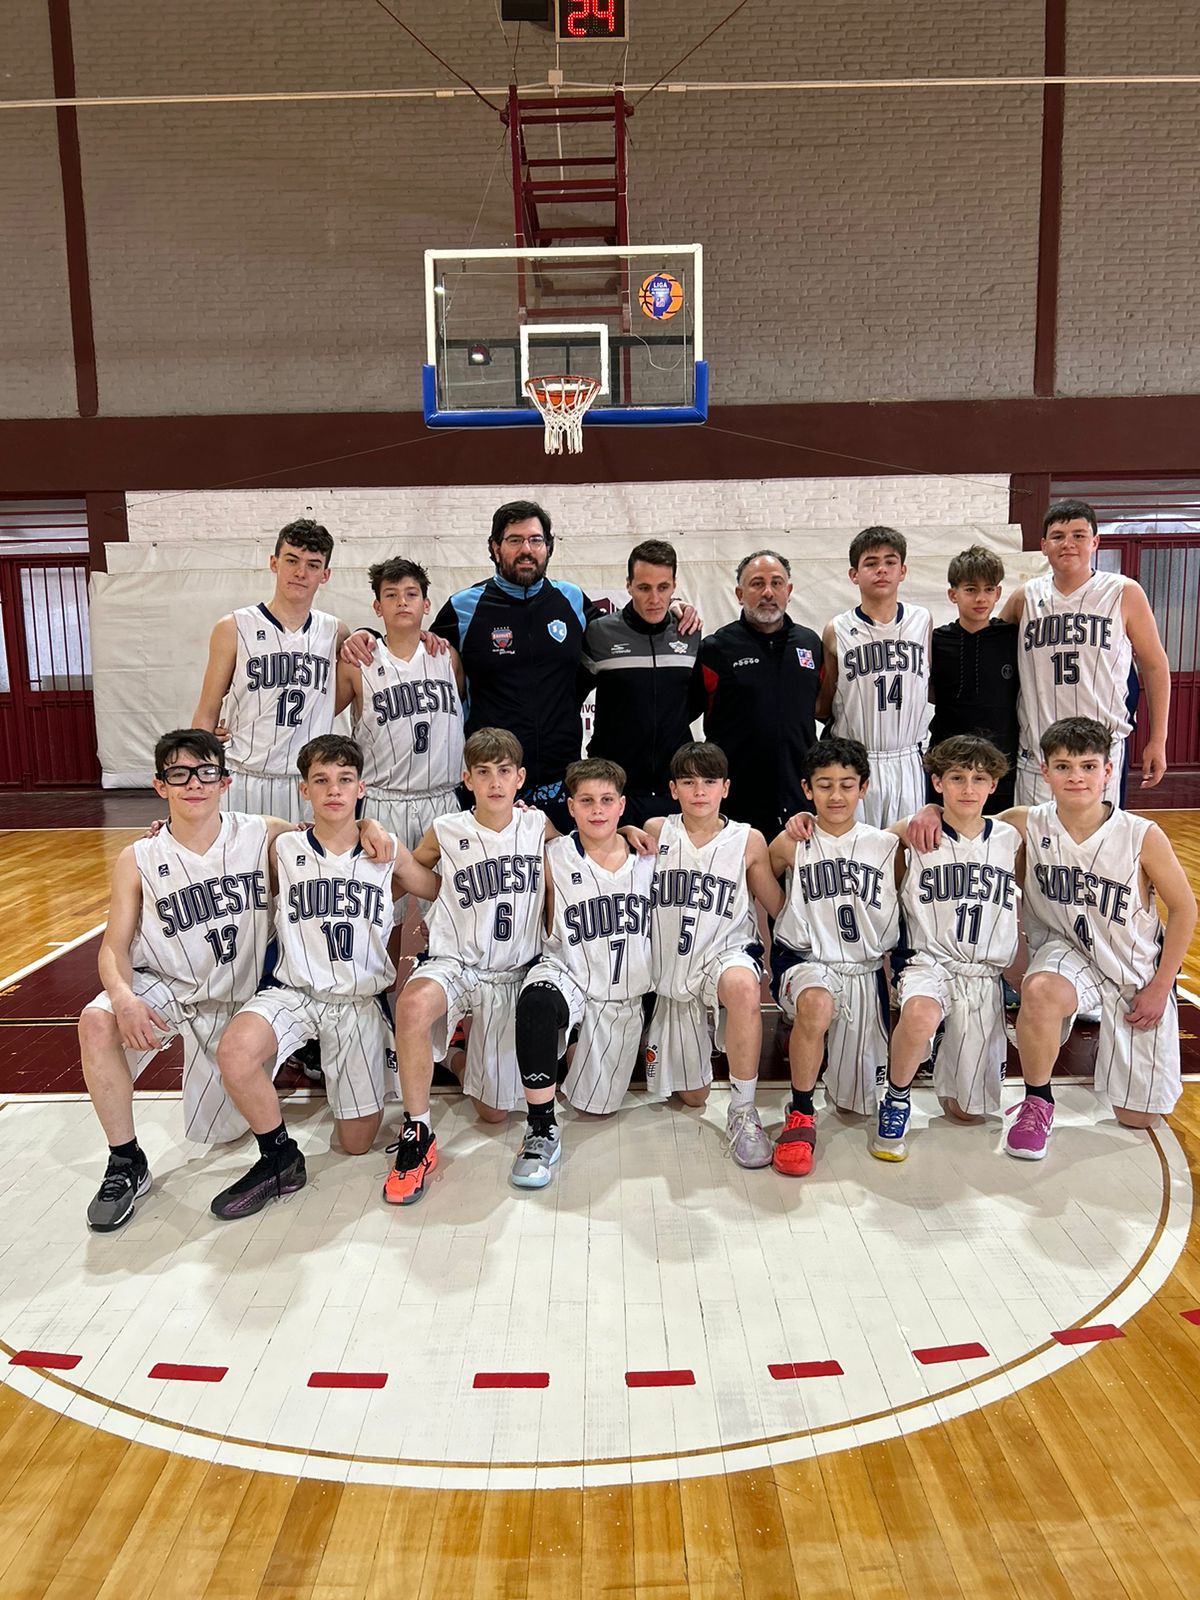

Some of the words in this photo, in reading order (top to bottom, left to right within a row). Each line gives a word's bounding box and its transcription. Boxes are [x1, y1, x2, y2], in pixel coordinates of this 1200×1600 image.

[567, 0, 614, 35] 24
[1024, 613, 1112, 651] SUDESTE
[844, 639, 924, 681] SUDESTE
[1051, 651, 1080, 685] 15
[276, 689, 305, 727] 12
[372, 679, 458, 726] SUDESTE
[874, 675, 903, 711] 14
[413, 721, 430, 754] 8
[288, 877, 384, 927] SUDESTE
[453, 854, 542, 909] SUDESTE
[650, 869, 737, 919] SUDESTE
[919, 862, 1016, 911] SUDESTE
[1034, 863, 1131, 926] SUDESTE
[155, 870, 268, 938] SUDESTE
[493, 902, 513, 941] 6
[564, 893, 651, 946] SUDEST
[838, 904, 861, 943] 9
[955, 903, 983, 944] 11
[204, 923, 239, 967] 13
[320, 922, 354, 961] 10
[678, 915, 695, 955] 5
[1073, 914, 1092, 951] 4
[610, 939, 625, 985] 7
